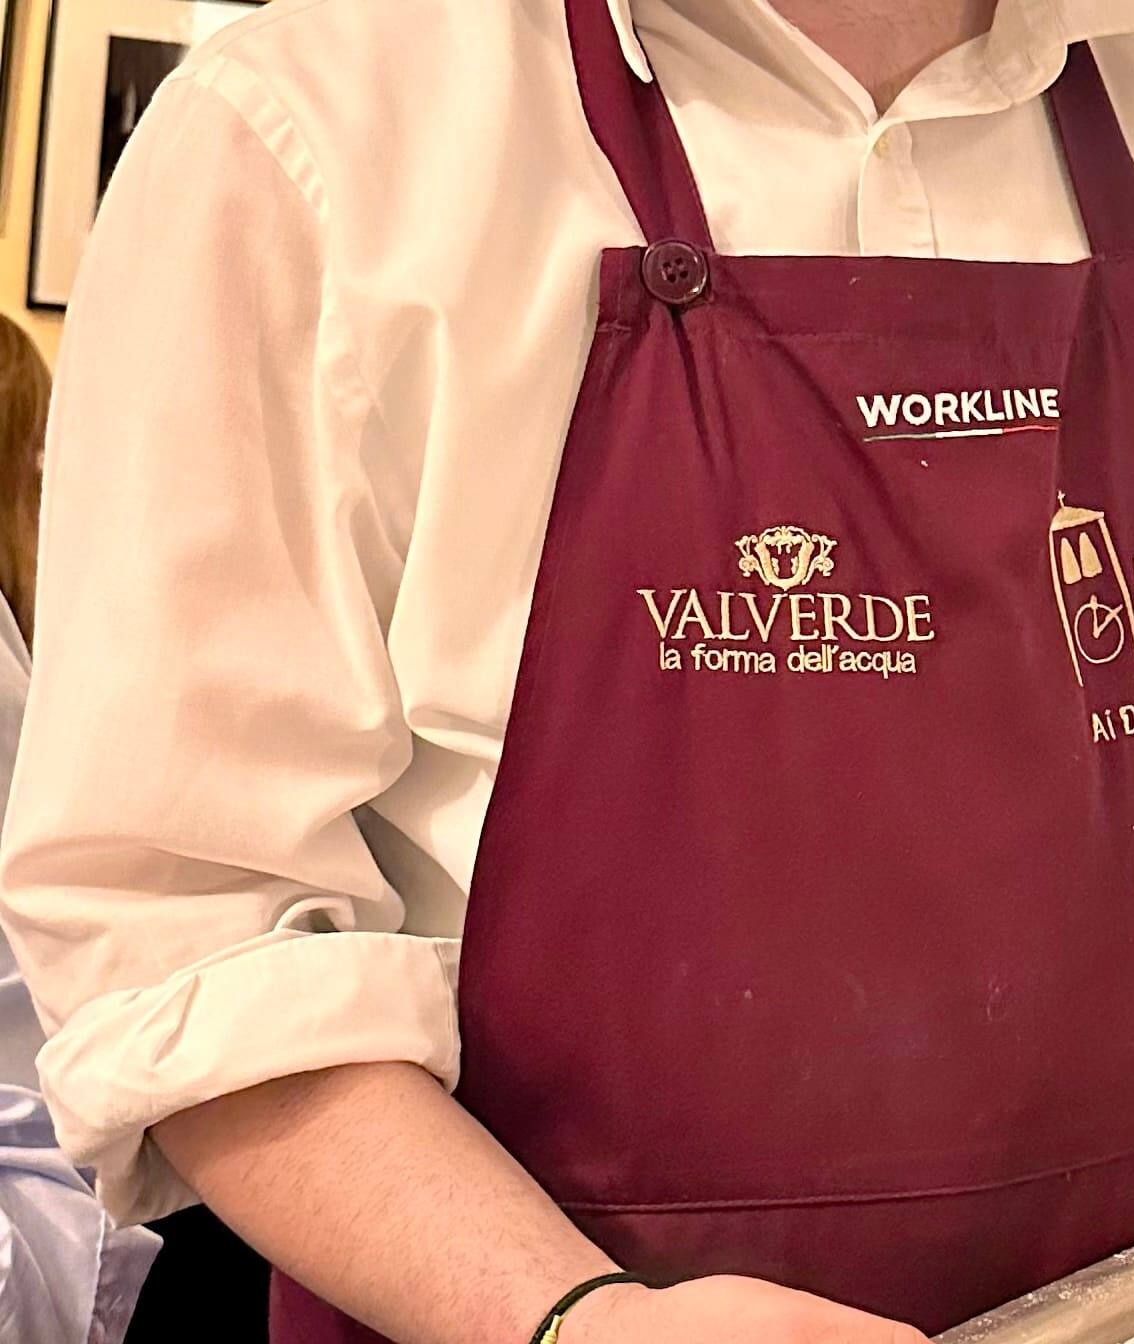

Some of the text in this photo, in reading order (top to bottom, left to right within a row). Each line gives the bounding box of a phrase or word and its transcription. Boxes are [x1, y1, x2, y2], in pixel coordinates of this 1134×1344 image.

[856, 388, 1060, 428] WORKLINE
[636, 588, 935, 642] VALVERDE
[659, 641, 916, 679] la forma dell'acqua
[1091, 709, 1116, 743] Ai
